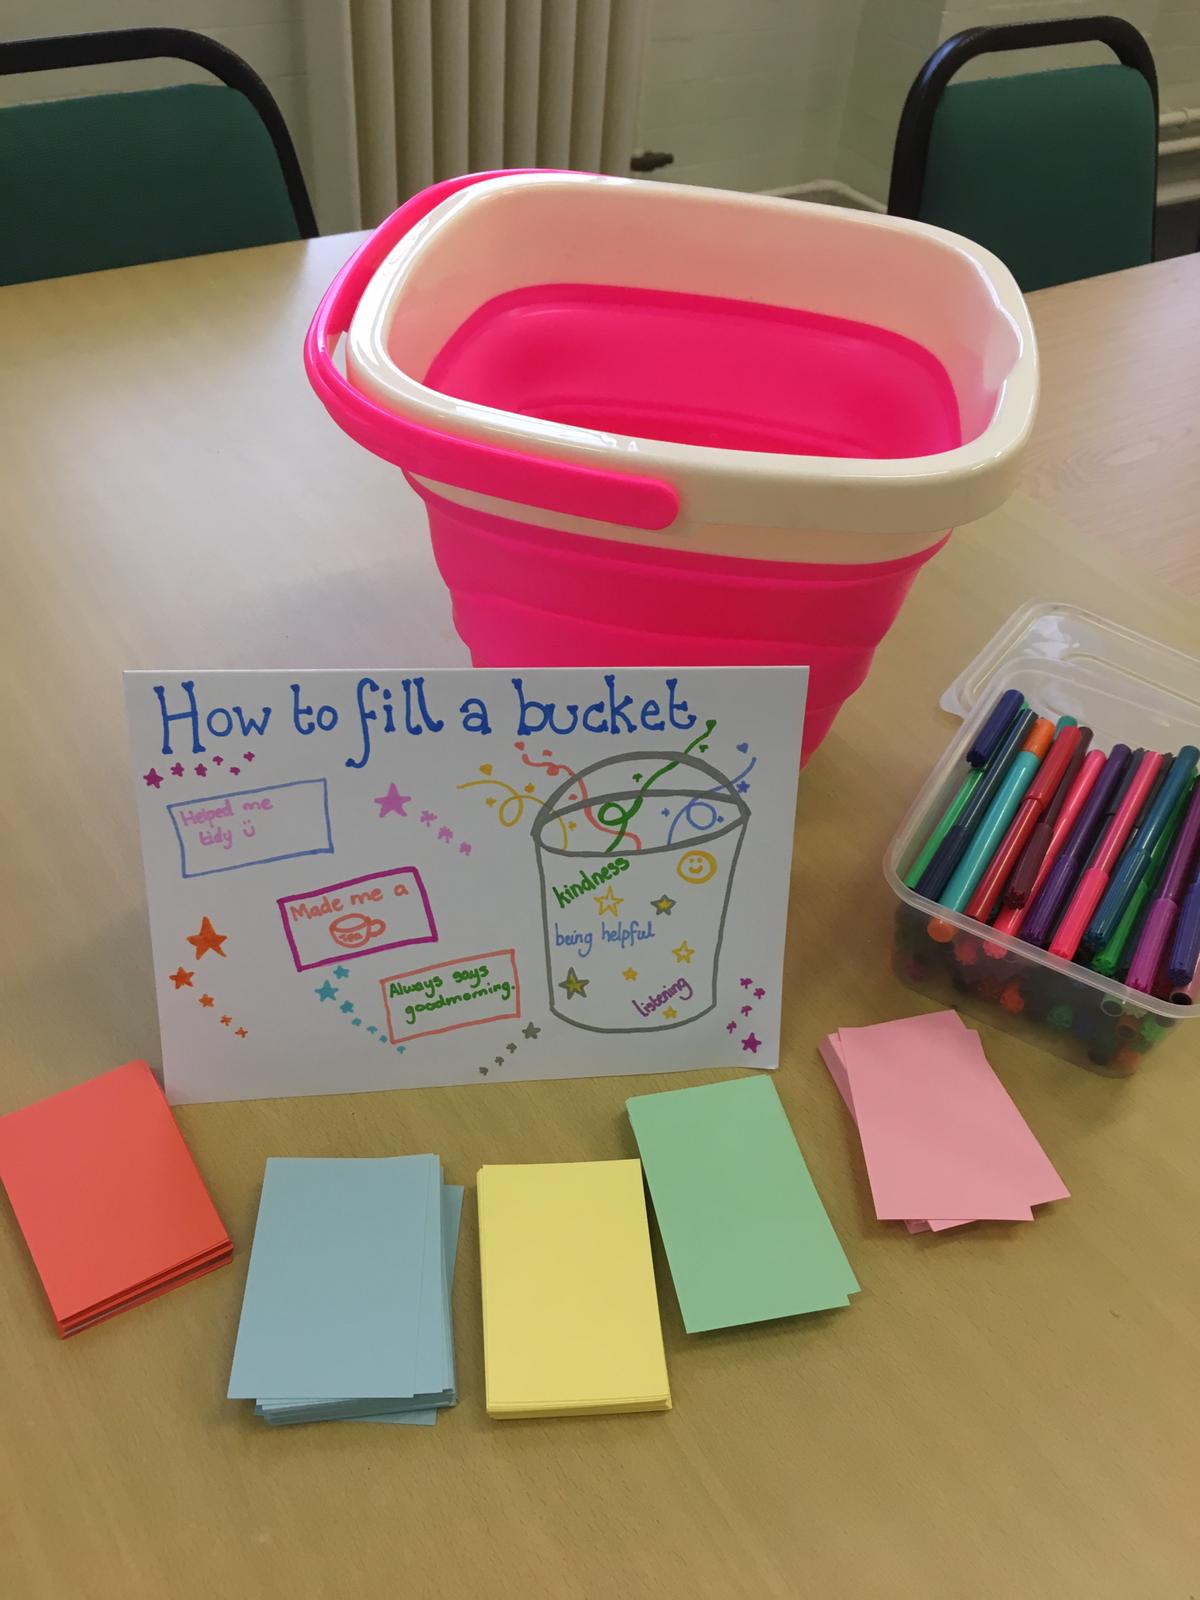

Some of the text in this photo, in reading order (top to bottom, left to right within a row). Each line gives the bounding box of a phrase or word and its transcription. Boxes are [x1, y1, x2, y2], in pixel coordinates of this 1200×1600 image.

[153, 674, 696, 768] How to fill a bucket
[180, 798, 274, 829] Helped me
[198, 827, 233, 850] tidy
[552, 857, 630, 909] kindness
[289, 884, 409, 922] Made me a
[554, 920, 655, 958] being helpful
[389, 965, 489, 998] Always says
[631, 977, 694, 1018] listening
[404, 981, 515, 1025] goodmorning.
